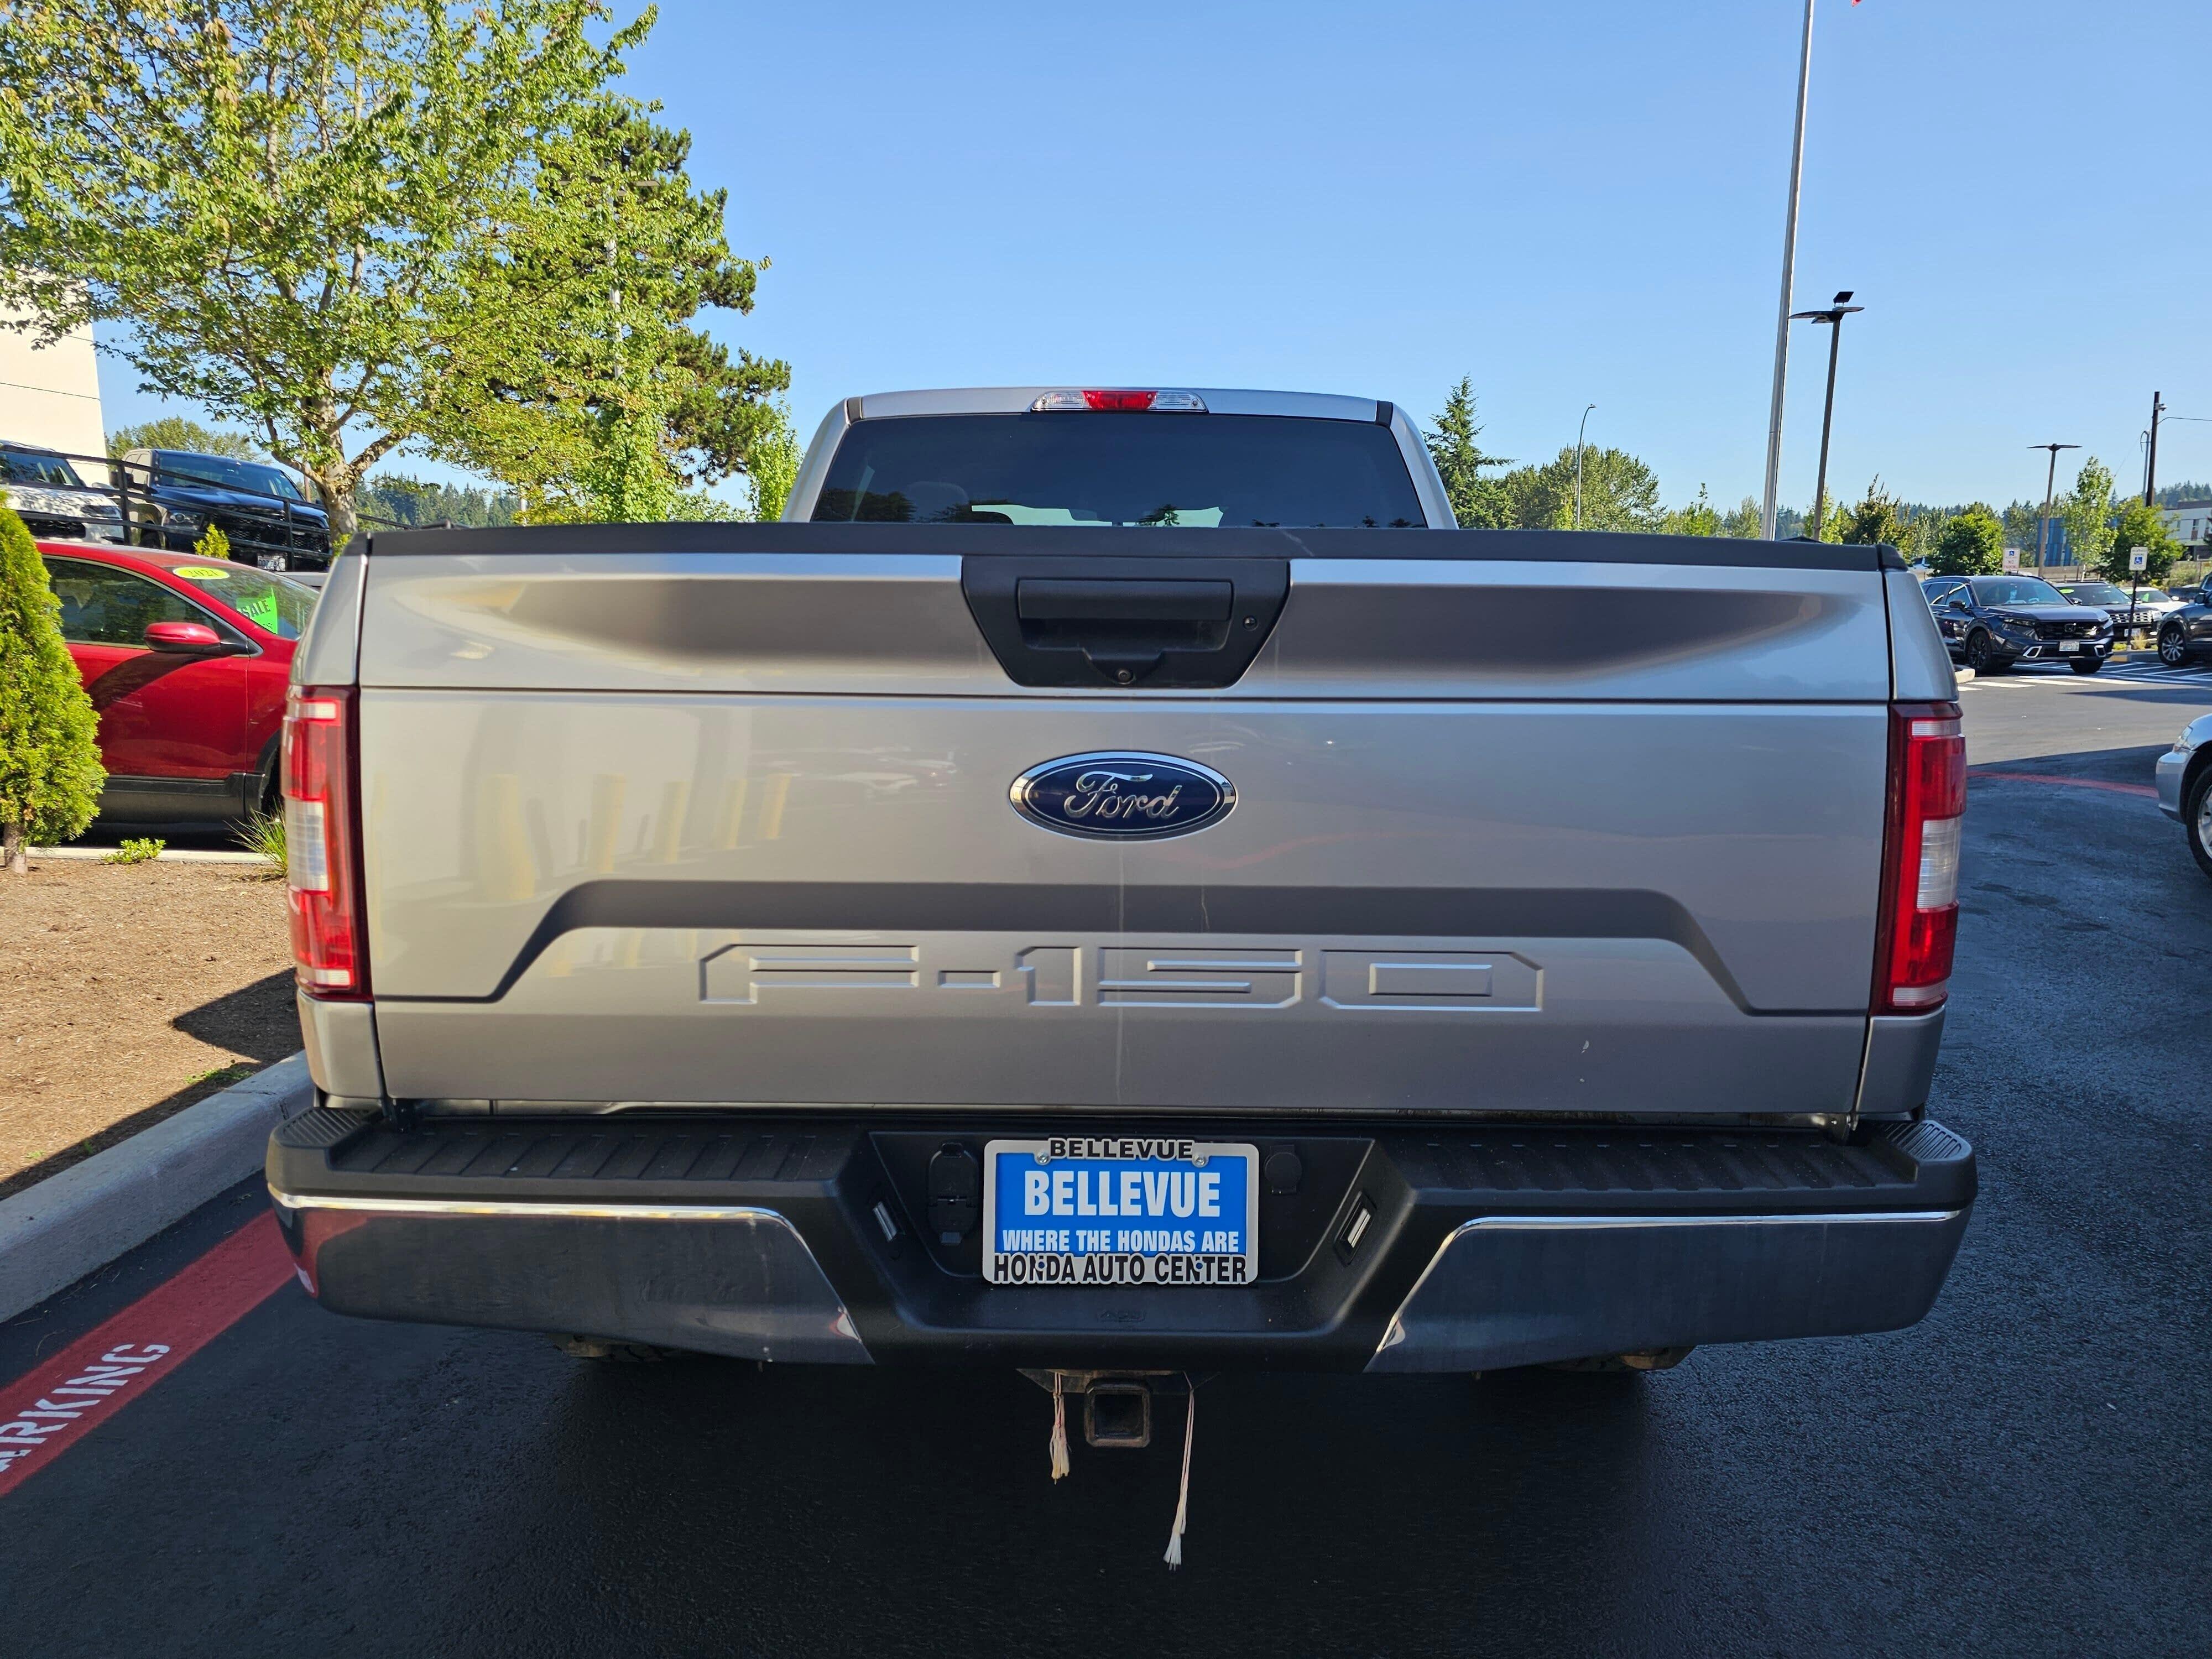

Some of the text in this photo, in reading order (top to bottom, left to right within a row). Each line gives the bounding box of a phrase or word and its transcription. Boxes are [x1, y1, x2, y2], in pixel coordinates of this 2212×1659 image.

[243, 599, 271, 618] SALE
[1063, 771, 1182, 819] Ford
[698, 942, 1543, 1011] F-150
[1050, 1139, 1193, 1159] BELLEVUE
[1024, 1170, 1221, 1218] BELLEVUE
[1003, 1229, 1239, 1253] WHERE THE HONDAS ARE
[994, 1255, 1246, 1283] HONDA AUTO CENTER
